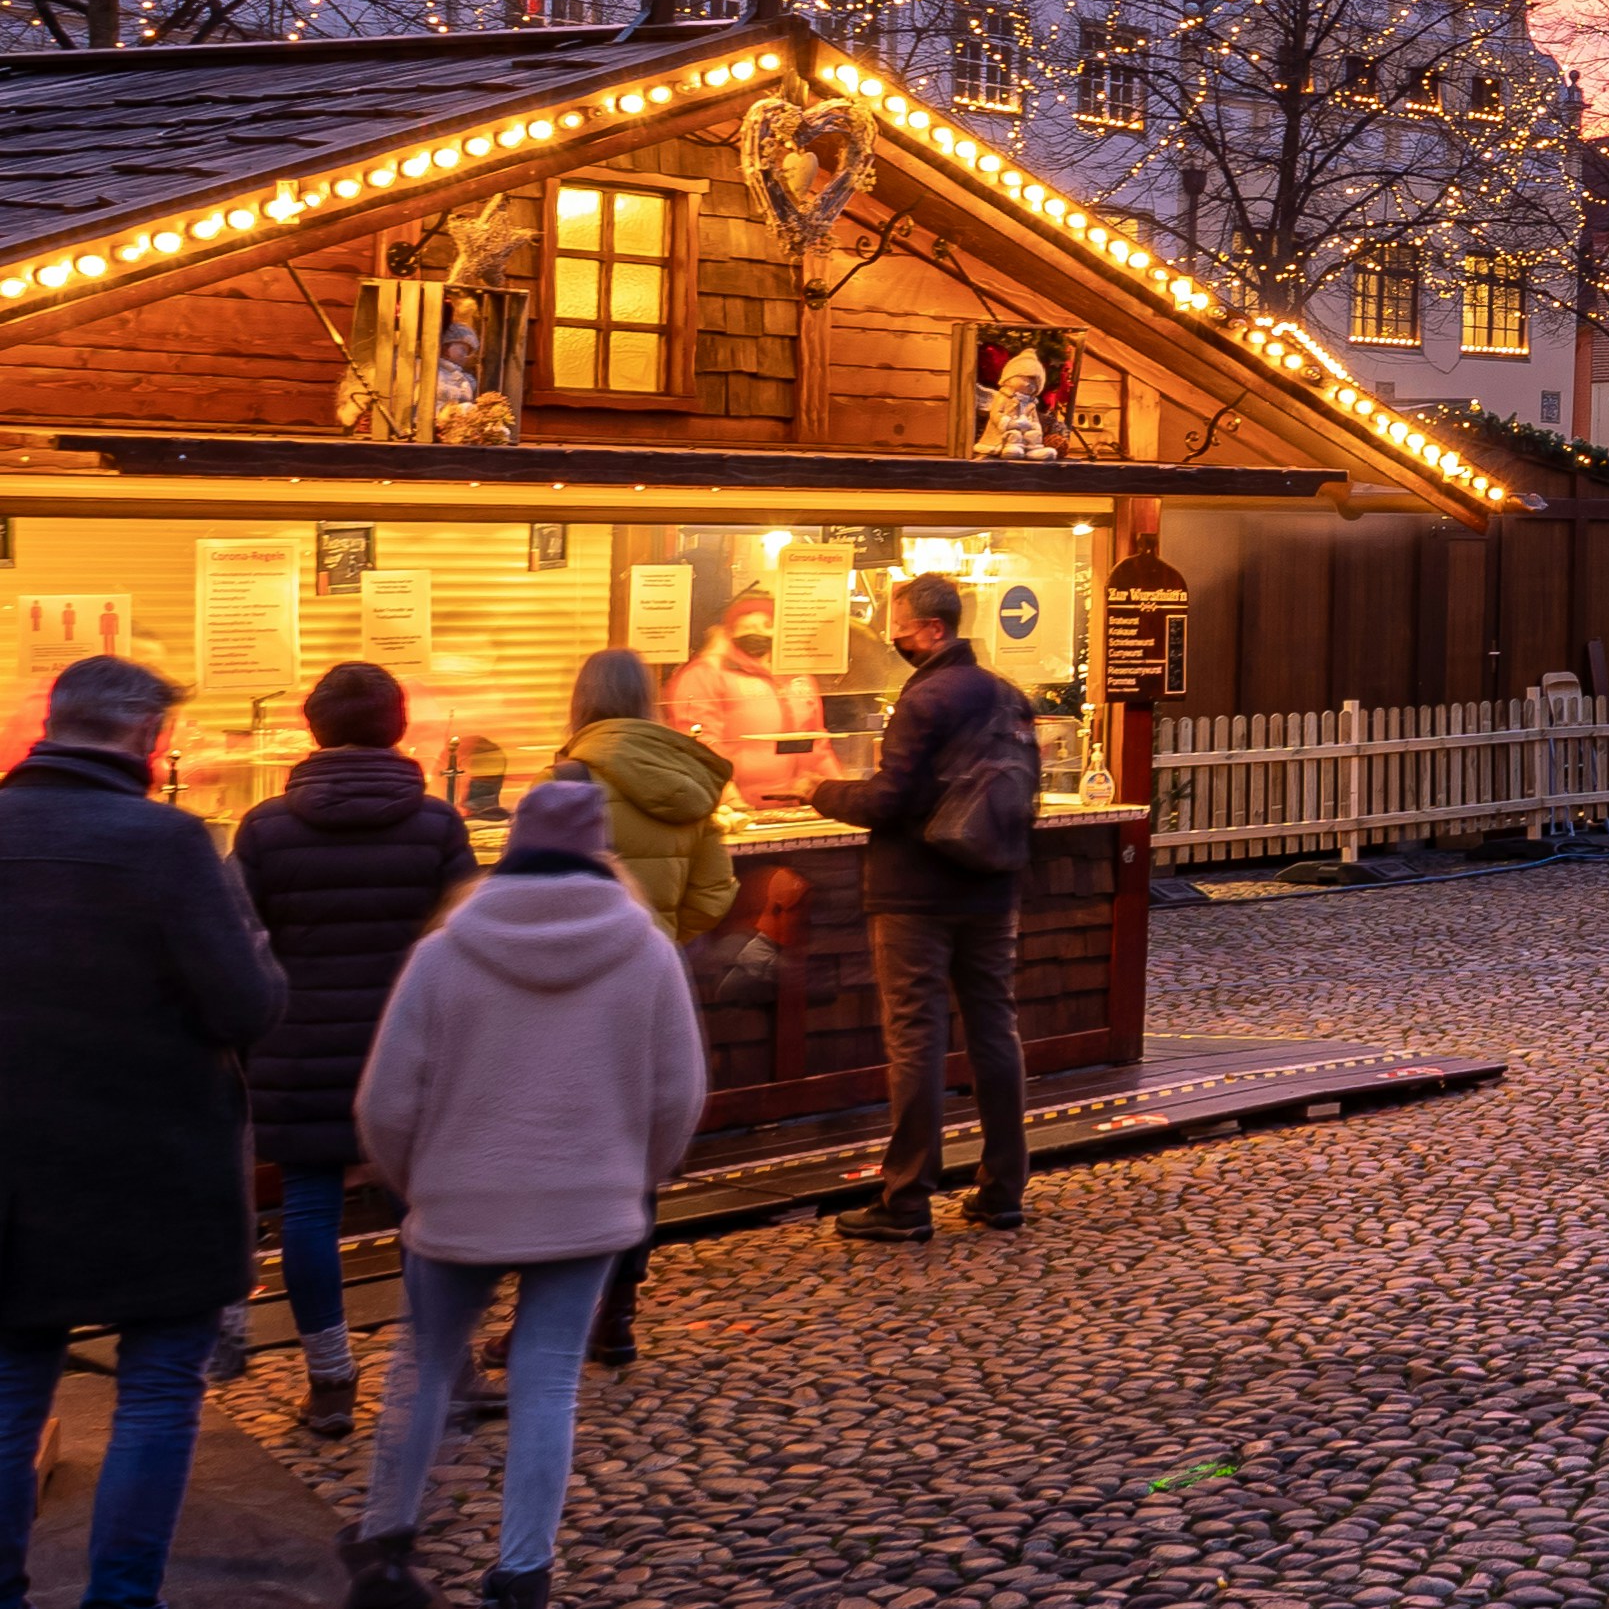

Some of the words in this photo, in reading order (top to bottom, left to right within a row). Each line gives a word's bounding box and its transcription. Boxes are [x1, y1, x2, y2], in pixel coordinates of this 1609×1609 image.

[210, 551, 286, 562] Corona-Regeln
[788, 553, 843, 563] Corona-Regeln
[1108, 588, 1128, 601] Zur
[1109, 616, 1140, 625] Bratwurst
[1108, 627, 1138, 636] Krakauer
[1108, 638, 1155, 647] Schinkenwurst
[1108, 649, 1143, 659] Currywurst
[1107, 666, 1162, 676] Riesencurrywurst
[1107, 677, 1136, 686] Pommes
